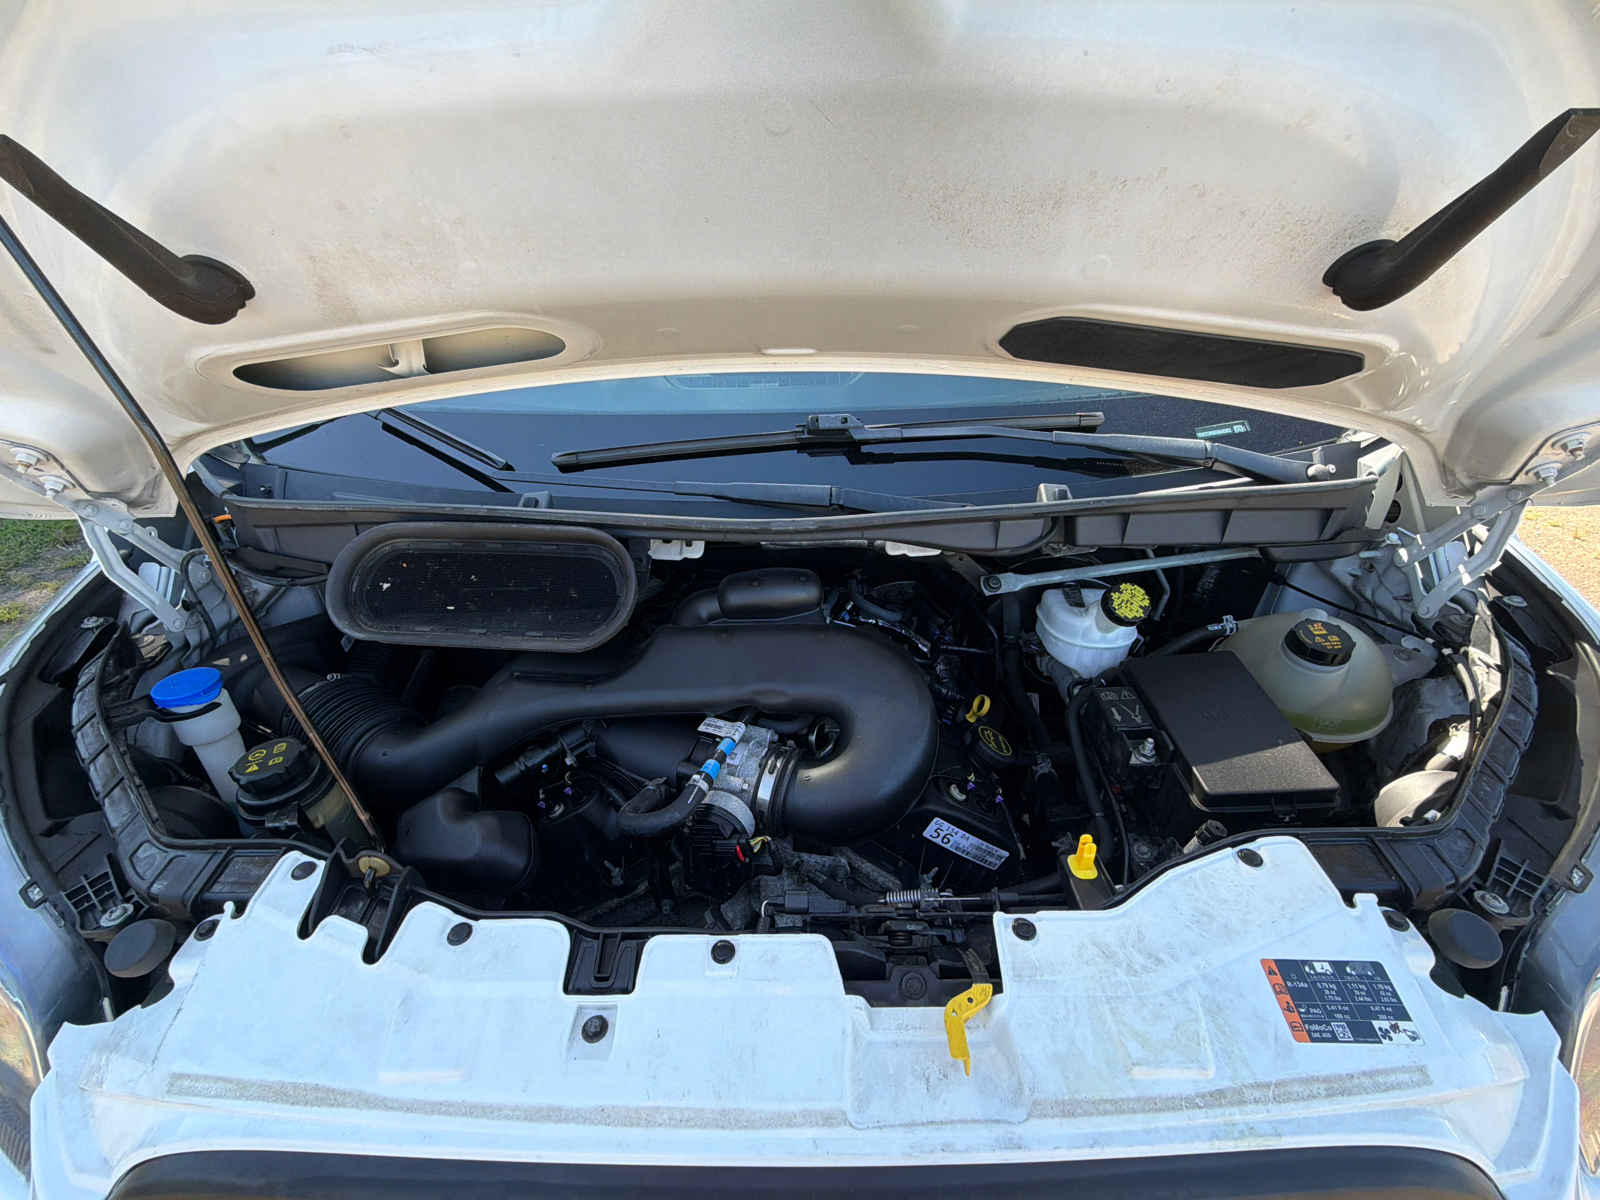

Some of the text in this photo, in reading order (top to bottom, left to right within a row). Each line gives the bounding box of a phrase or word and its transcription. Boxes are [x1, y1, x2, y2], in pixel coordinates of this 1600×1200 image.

[934, 820, 970, 842] GG 154 DA
[929, 827, 954, 845] 56
[1328, 982, 1337, 991] kg
[1358, 983, 1367, 991] kg
[1383, 984, 1392, 992] kg
[1305, 1023, 1332, 1031] FoMoCo
